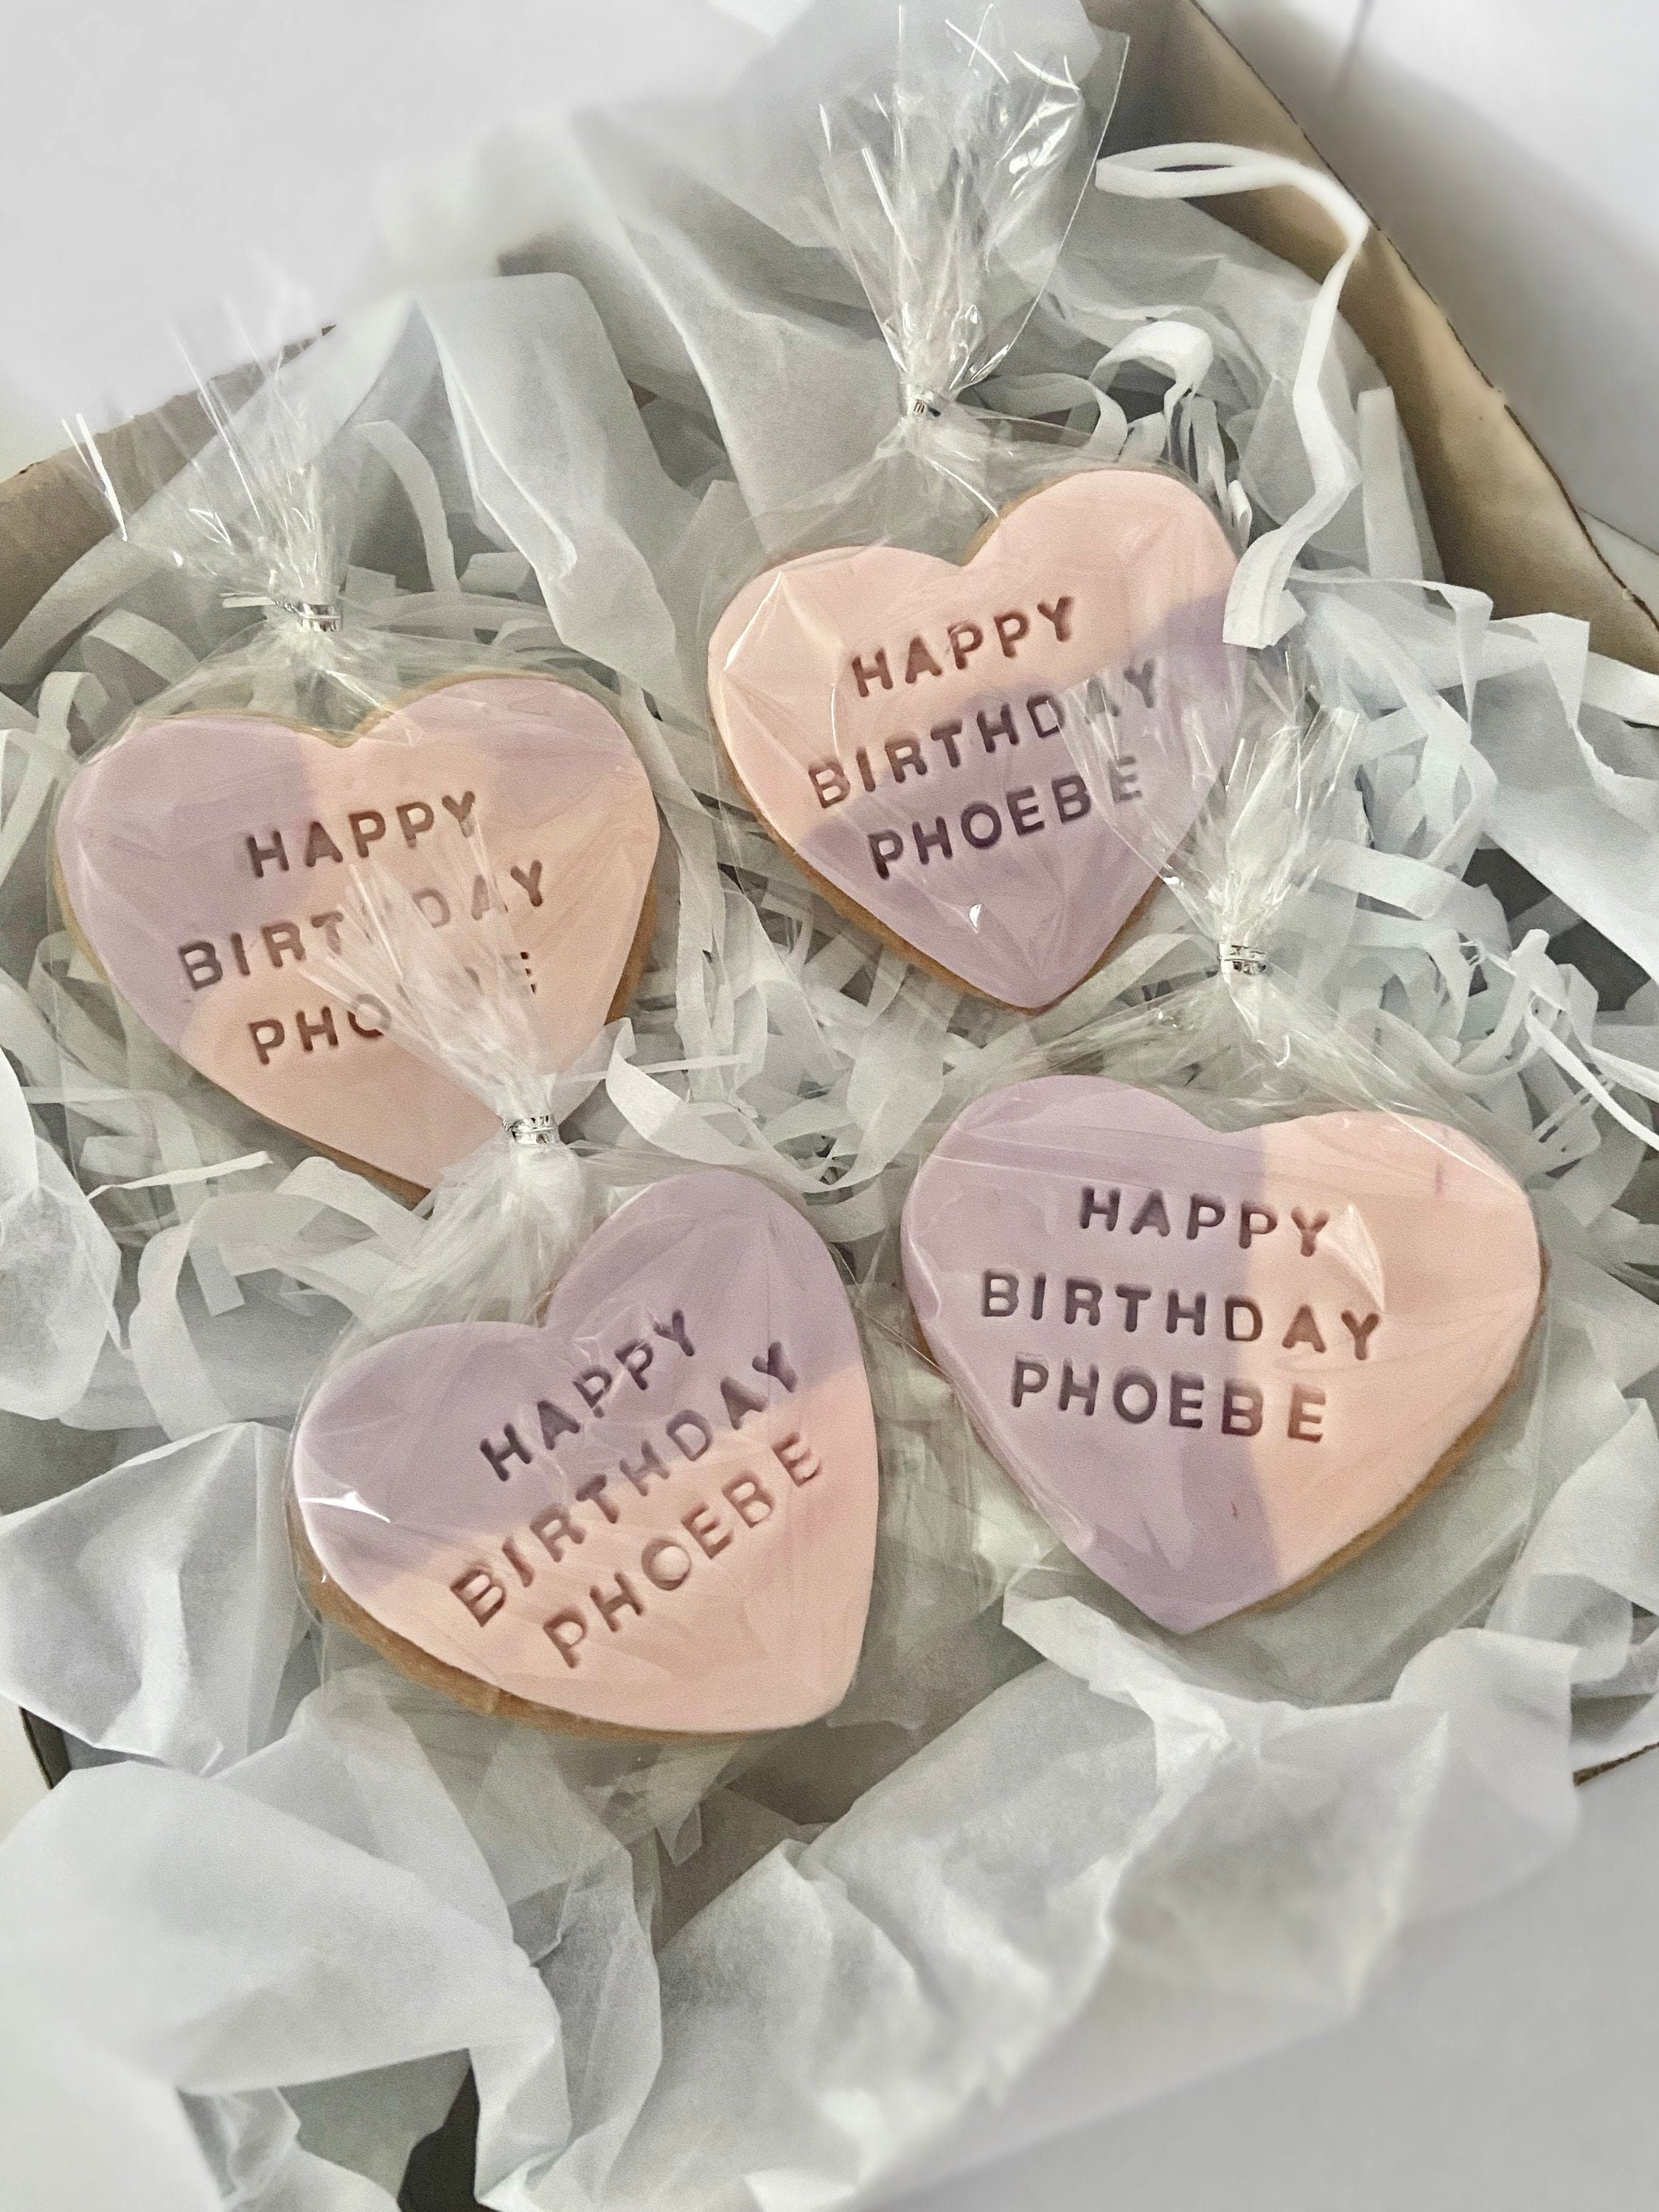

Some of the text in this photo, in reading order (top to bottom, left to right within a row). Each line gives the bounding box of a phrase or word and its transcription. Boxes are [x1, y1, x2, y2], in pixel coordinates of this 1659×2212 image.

[852, 595, 1076, 698] HAPPY
[808, 661, 1155, 809] BIRTHDAY
[246, 790, 476, 877] HAPPY
[867, 754, 1144, 880] PHOEBE
[178, 860, 543, 990] BIRTDAY
[1079, 1186, 1329, 1256] HAPPY
[981, 1268, 1380, 1360] BIRTHDAY
[479, 1309, 695, 1482] HAPPY
[1011, 1354, 1326, 1442] PHOEBE
[450, 1340, 798, 1628] BIRTHDAY
[541, 1432, 821, 1669] PHOEBE
